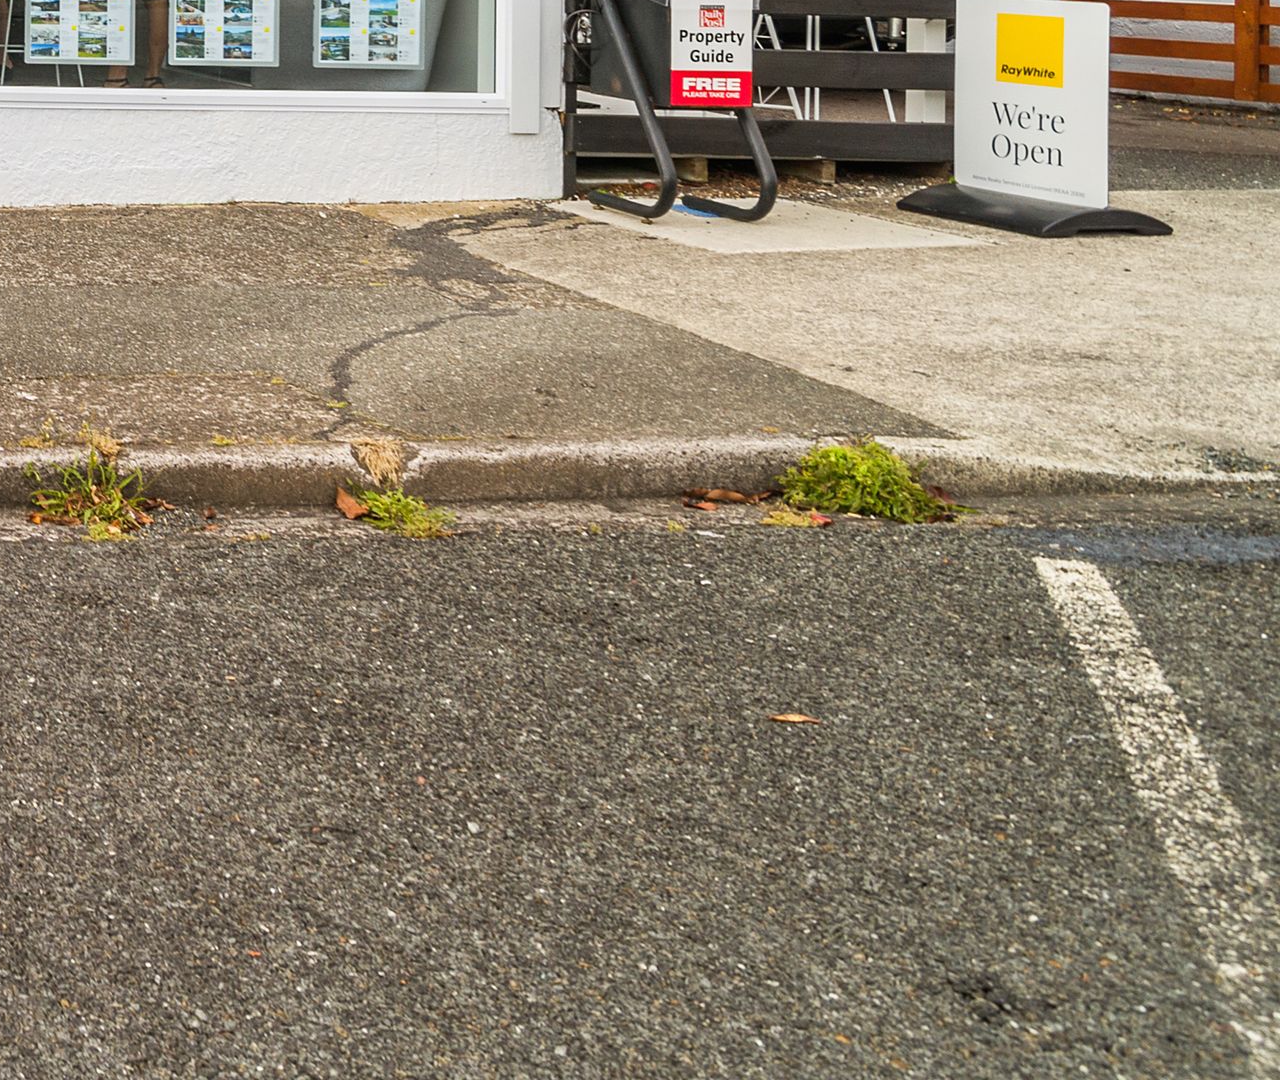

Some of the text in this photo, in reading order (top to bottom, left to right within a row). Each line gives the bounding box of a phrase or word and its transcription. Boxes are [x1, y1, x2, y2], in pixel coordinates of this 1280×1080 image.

[700, 10, 723, 20] Daily
[700, 18, 723, 27] Post
[680, 29, 745, 46] Property
[690, 49, 734, 63] Guide
[1001, 64, 1055, 79] RayWhite
[682, 77, 741, 91] FREE
[991, 101, 1065, 135] We're
[991, 132, 1064, 168] Open
